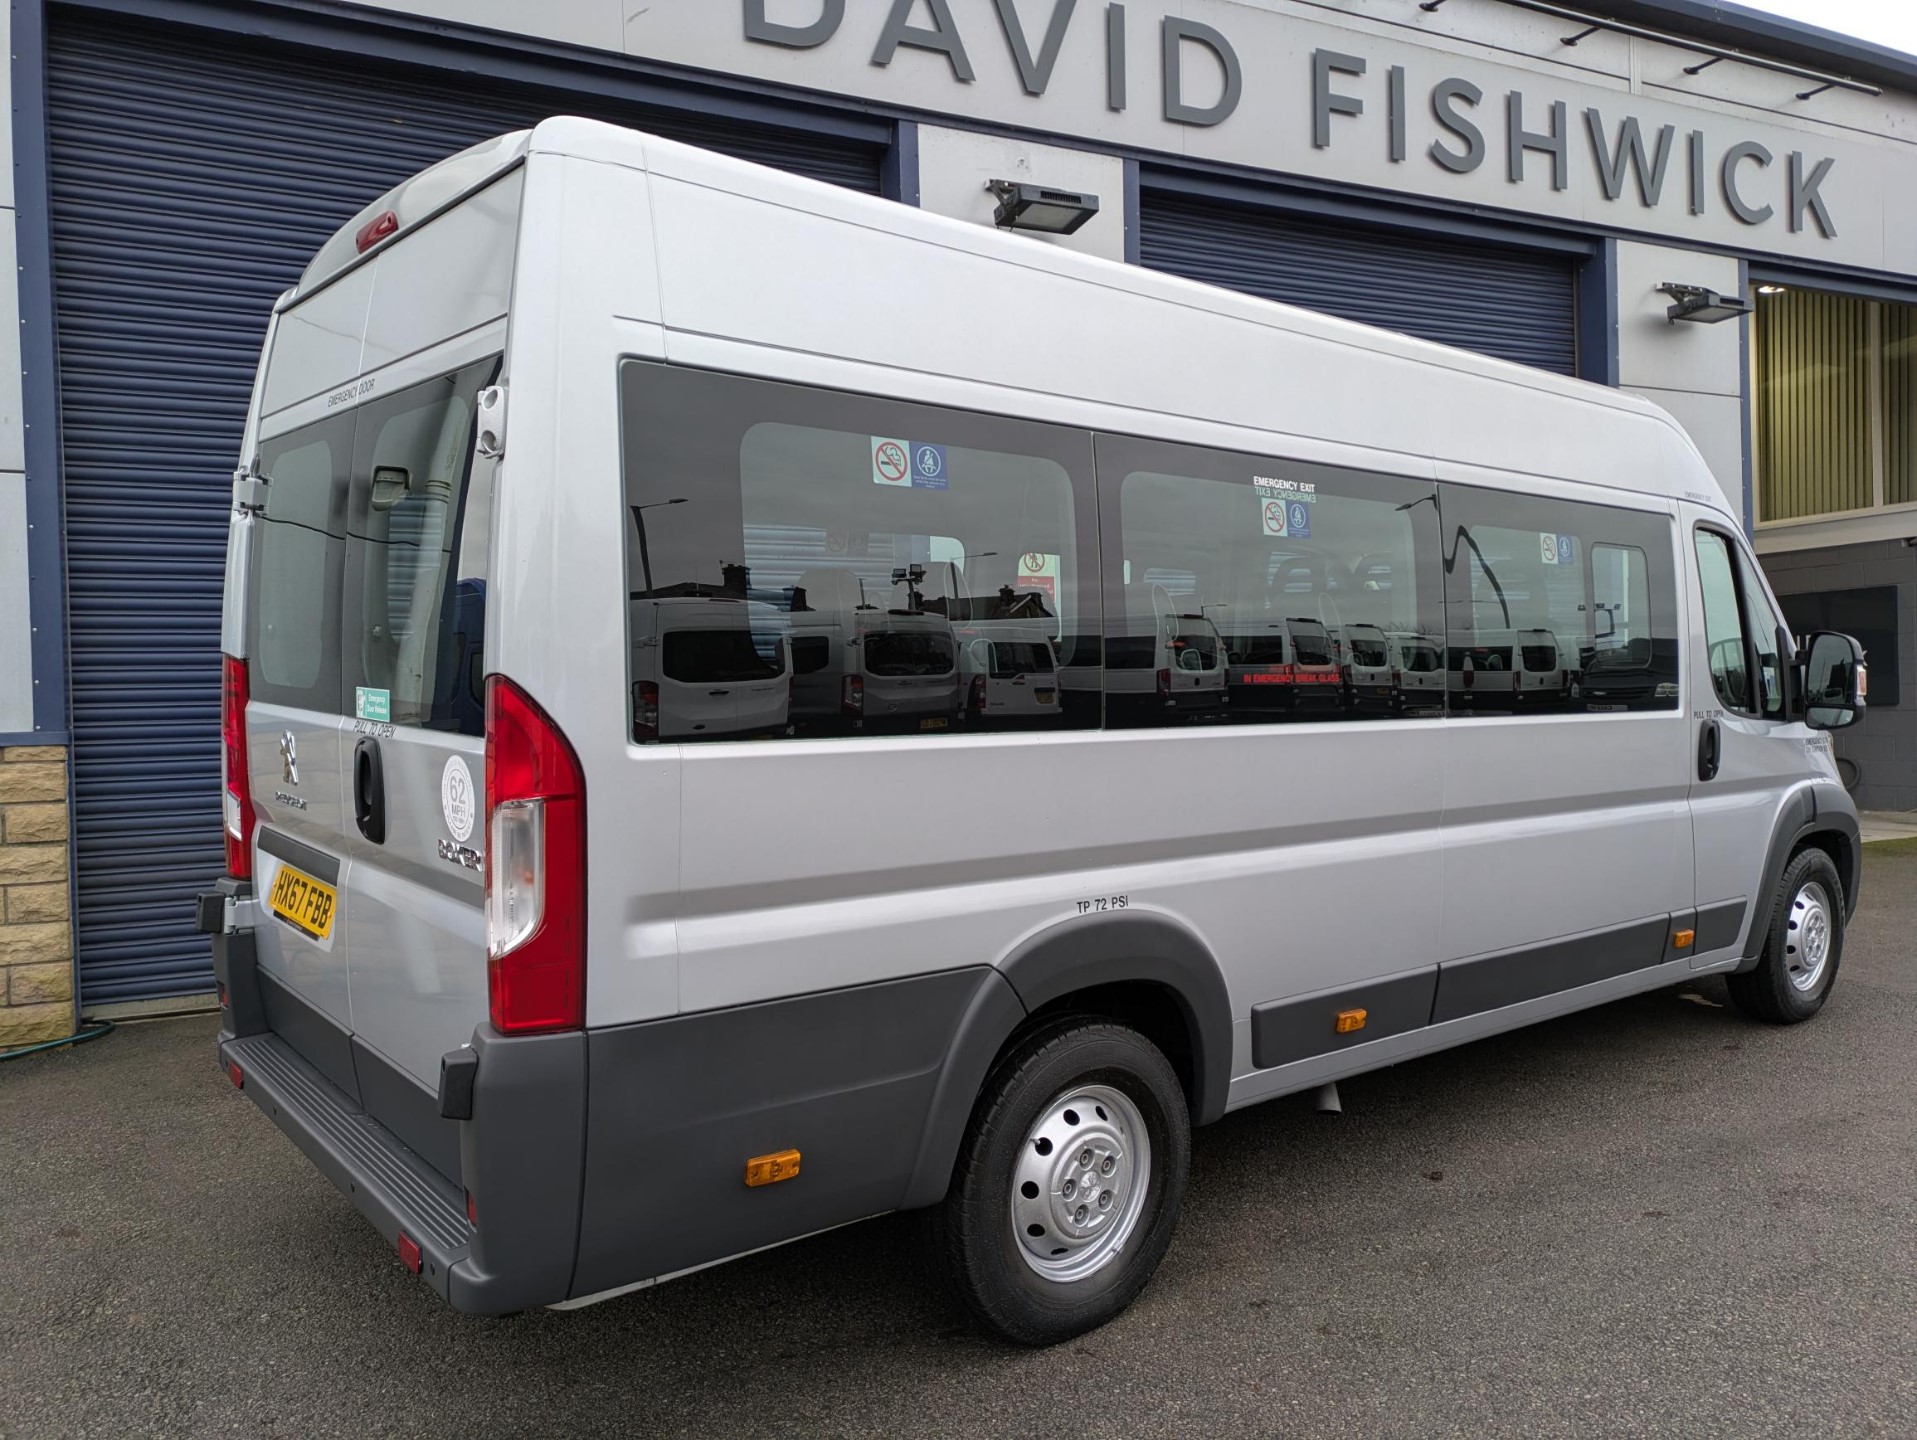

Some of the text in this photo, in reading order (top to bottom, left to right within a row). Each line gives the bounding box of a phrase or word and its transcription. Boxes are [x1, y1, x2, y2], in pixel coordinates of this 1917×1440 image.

[1313, 47, 1838, 239] FISHWICK
[328, 378, 375, 407] EMERGENCY DOOR
[1253, 476, 1315, 493] EMERGENCY EXIT
[1253, 673, 1294, 684] EMERGENCY
[1295, 673, 1317, 684] BREAK
[1318, 672, 1341, 683] GLASS
[1693, 710, 1704, 720] PULL
[1713, 709, 1725, 719] OPEN
[353, 720, 396, 738] PULL TO OPEN
[450, 776, 466, 804] 62
[451, 803, 466, 817] MPH
[274, 870, 333, 930] HX67 FBB
[1076, 894, 1129, 914] TP 72 PSI
